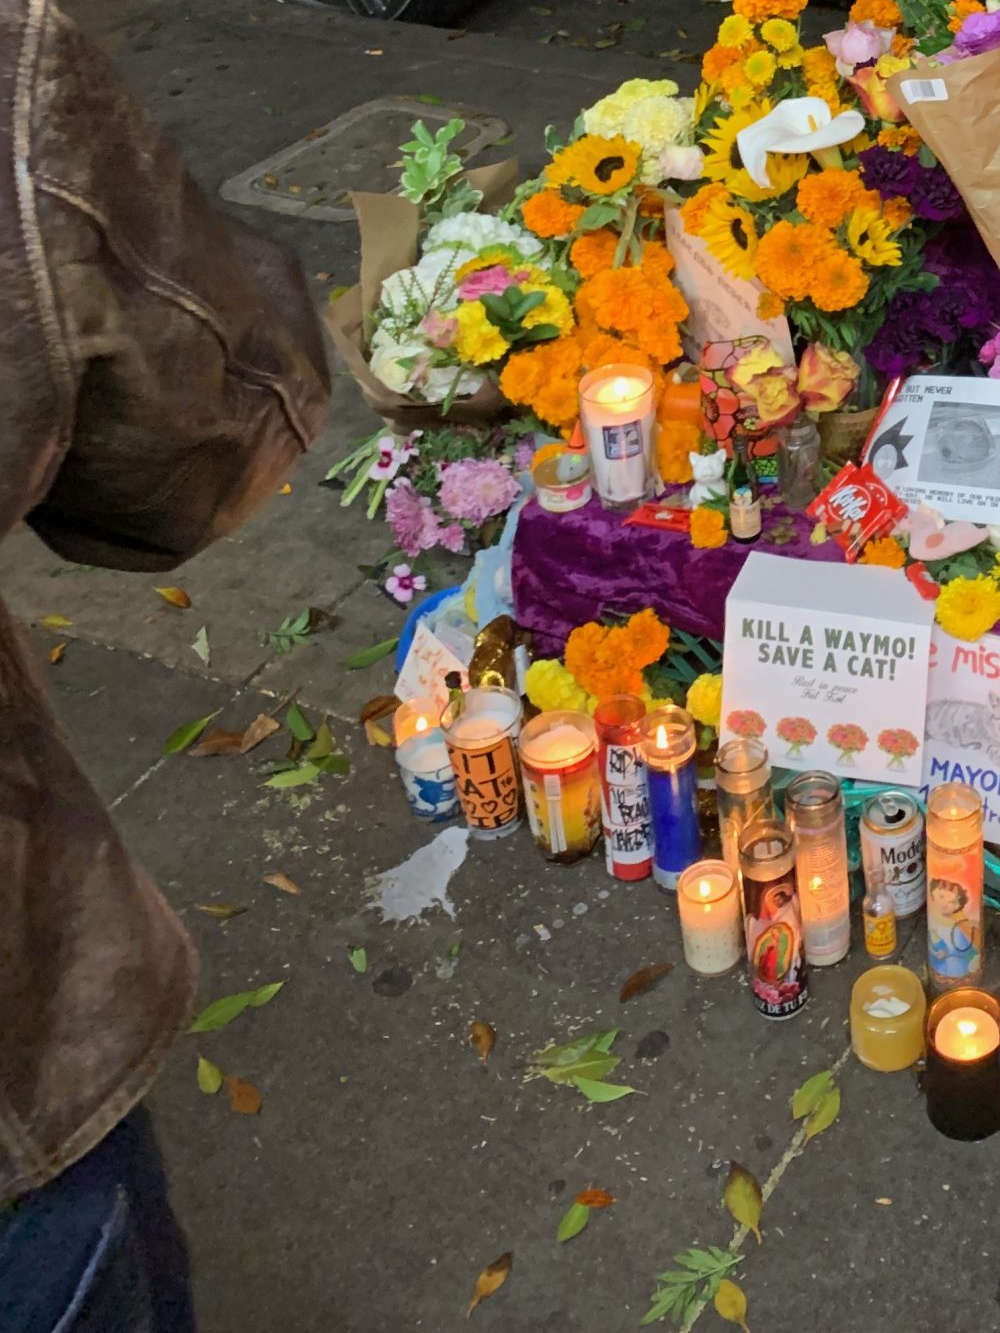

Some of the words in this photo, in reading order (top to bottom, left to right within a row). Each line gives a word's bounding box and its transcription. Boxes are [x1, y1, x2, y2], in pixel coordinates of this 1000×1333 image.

[741, 617, 790, 643] KILL
[799, 625, 814, 647] A
[824, 627, 916, 661] WAYMO!
[758, 642, 815, 670] SAVE
[822, 651, 838, 674] A
[847, 655, 897, 682] CAT!
[449, 749, 497, 776] IT
